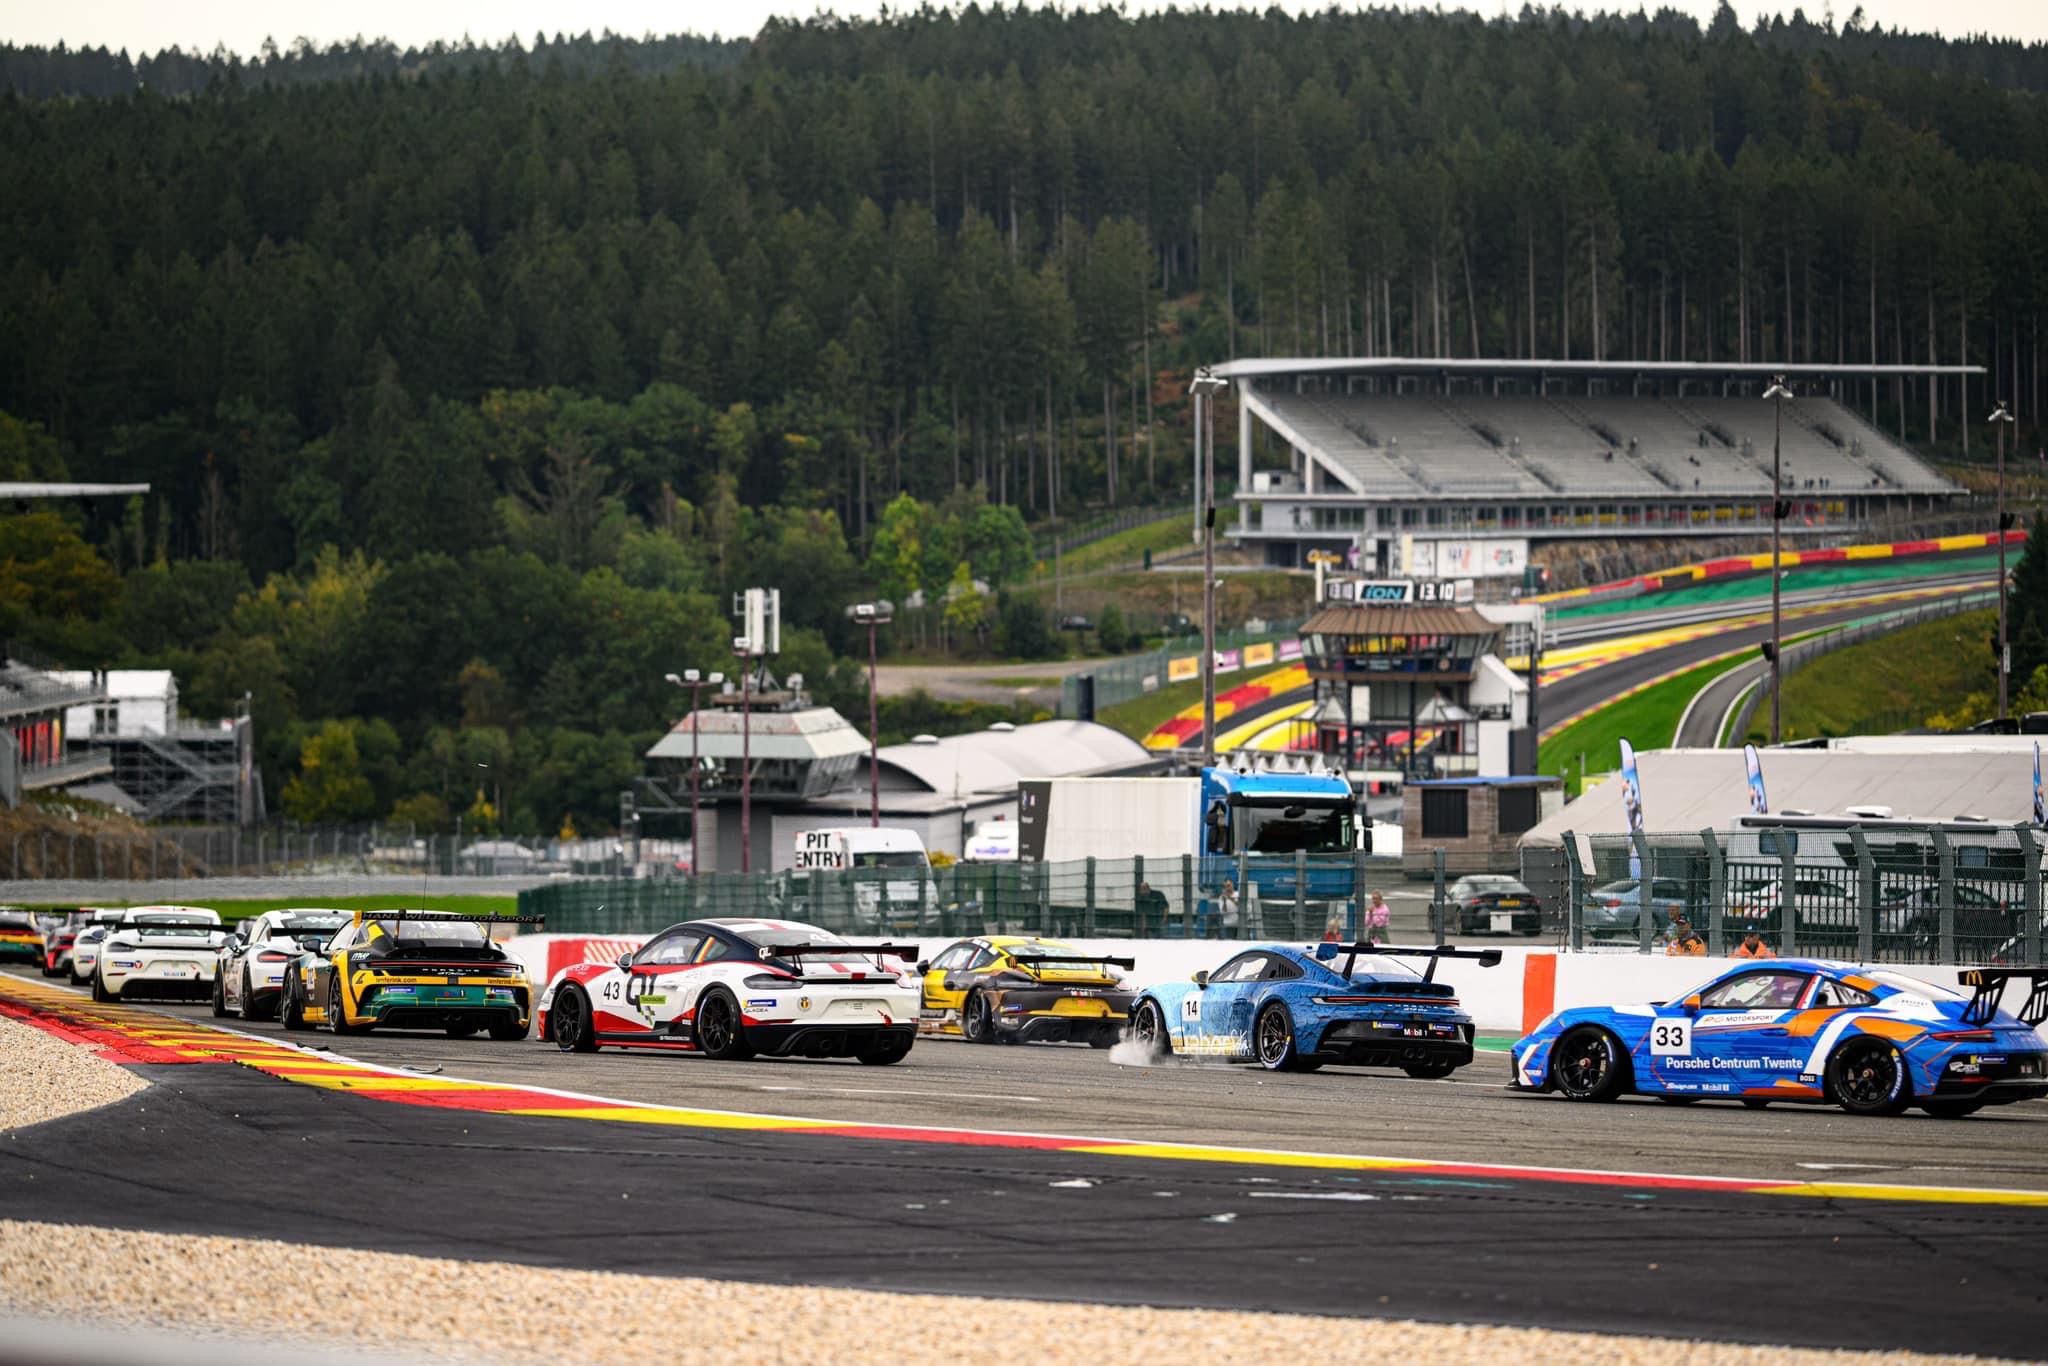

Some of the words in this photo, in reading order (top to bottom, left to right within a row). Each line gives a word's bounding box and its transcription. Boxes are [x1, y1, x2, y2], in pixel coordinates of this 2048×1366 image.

[807, 833, 831, 848] PIT
[796, 851, 842, 867] ENTRY
[603, 981, 620, 1000] 43
[1186, 1000, 1197, 1016] 14
[1656, 1026, 1683, 1047] 33
[1666, 1057, 1710, 1069] Porsche
[1712, 1057, 1760, 1069] Centrum
[1762, 1057, 1803, 1069] Twente
